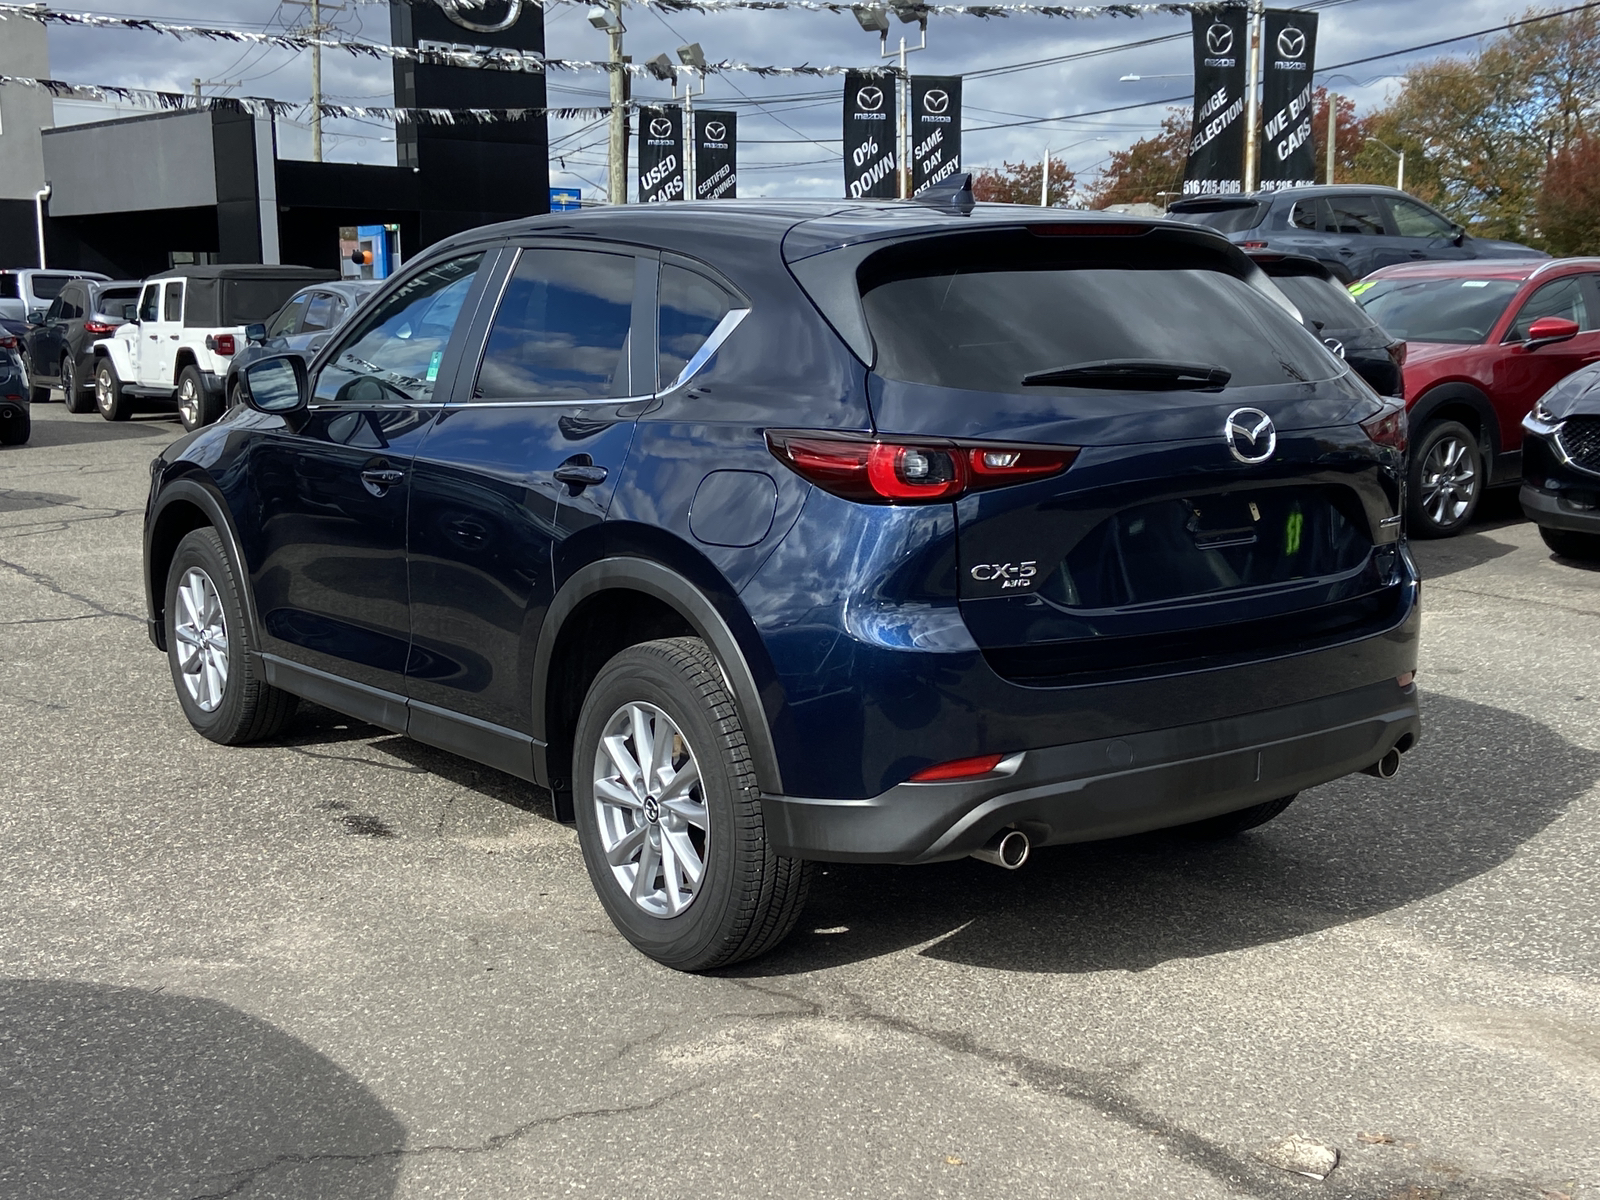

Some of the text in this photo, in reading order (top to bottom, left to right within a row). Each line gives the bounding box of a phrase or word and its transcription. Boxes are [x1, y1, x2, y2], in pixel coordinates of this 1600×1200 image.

[1198, 86, 1229, 124] HUGE
[1264, 82, 1312, 142] WE BUY
[914, 127, 944, 160] SAME
[1189, 97, 1244, 157] SELECTION
[1277, 116, 1312, 162] CARS
[852, 136, 879, 167] 0%
[922, 148, 942, 174] DAY
[641, 154, 677, 190] USED
[697, 164, 730, 195] CERTIFIED
[849, 151, 896, 199] DOWN
[1183, 179, 1241, 195] 516 285-0505
[970, 560, 1037, 581] CX-5
[1001, 578, 1031, 589] AWD
